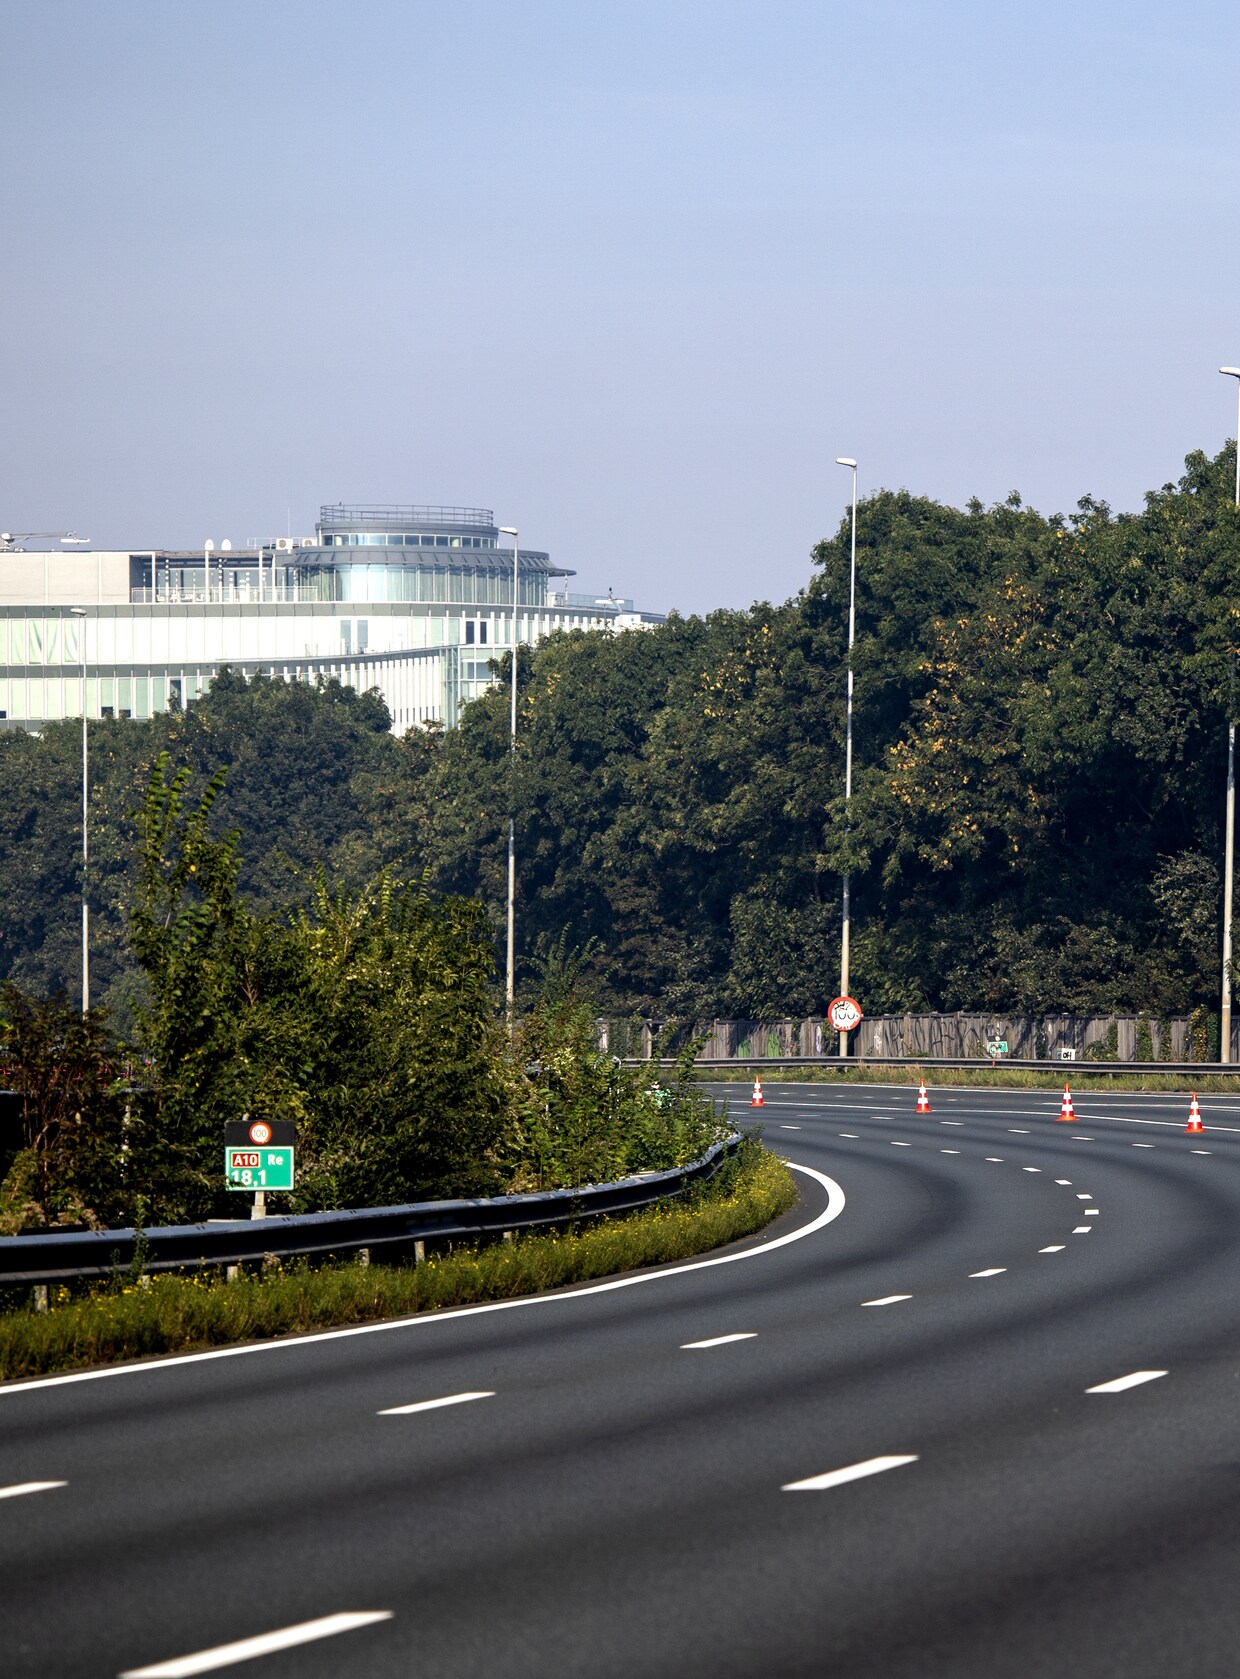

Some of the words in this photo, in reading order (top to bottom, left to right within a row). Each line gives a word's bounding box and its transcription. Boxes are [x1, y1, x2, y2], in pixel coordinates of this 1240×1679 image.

[253, 1129, 267, 1138] 100
[233, 1154, 258, 1166] A10
[267, 1154, 284, 1166] Re
[231, 1169, 267, 1187] 18,1
